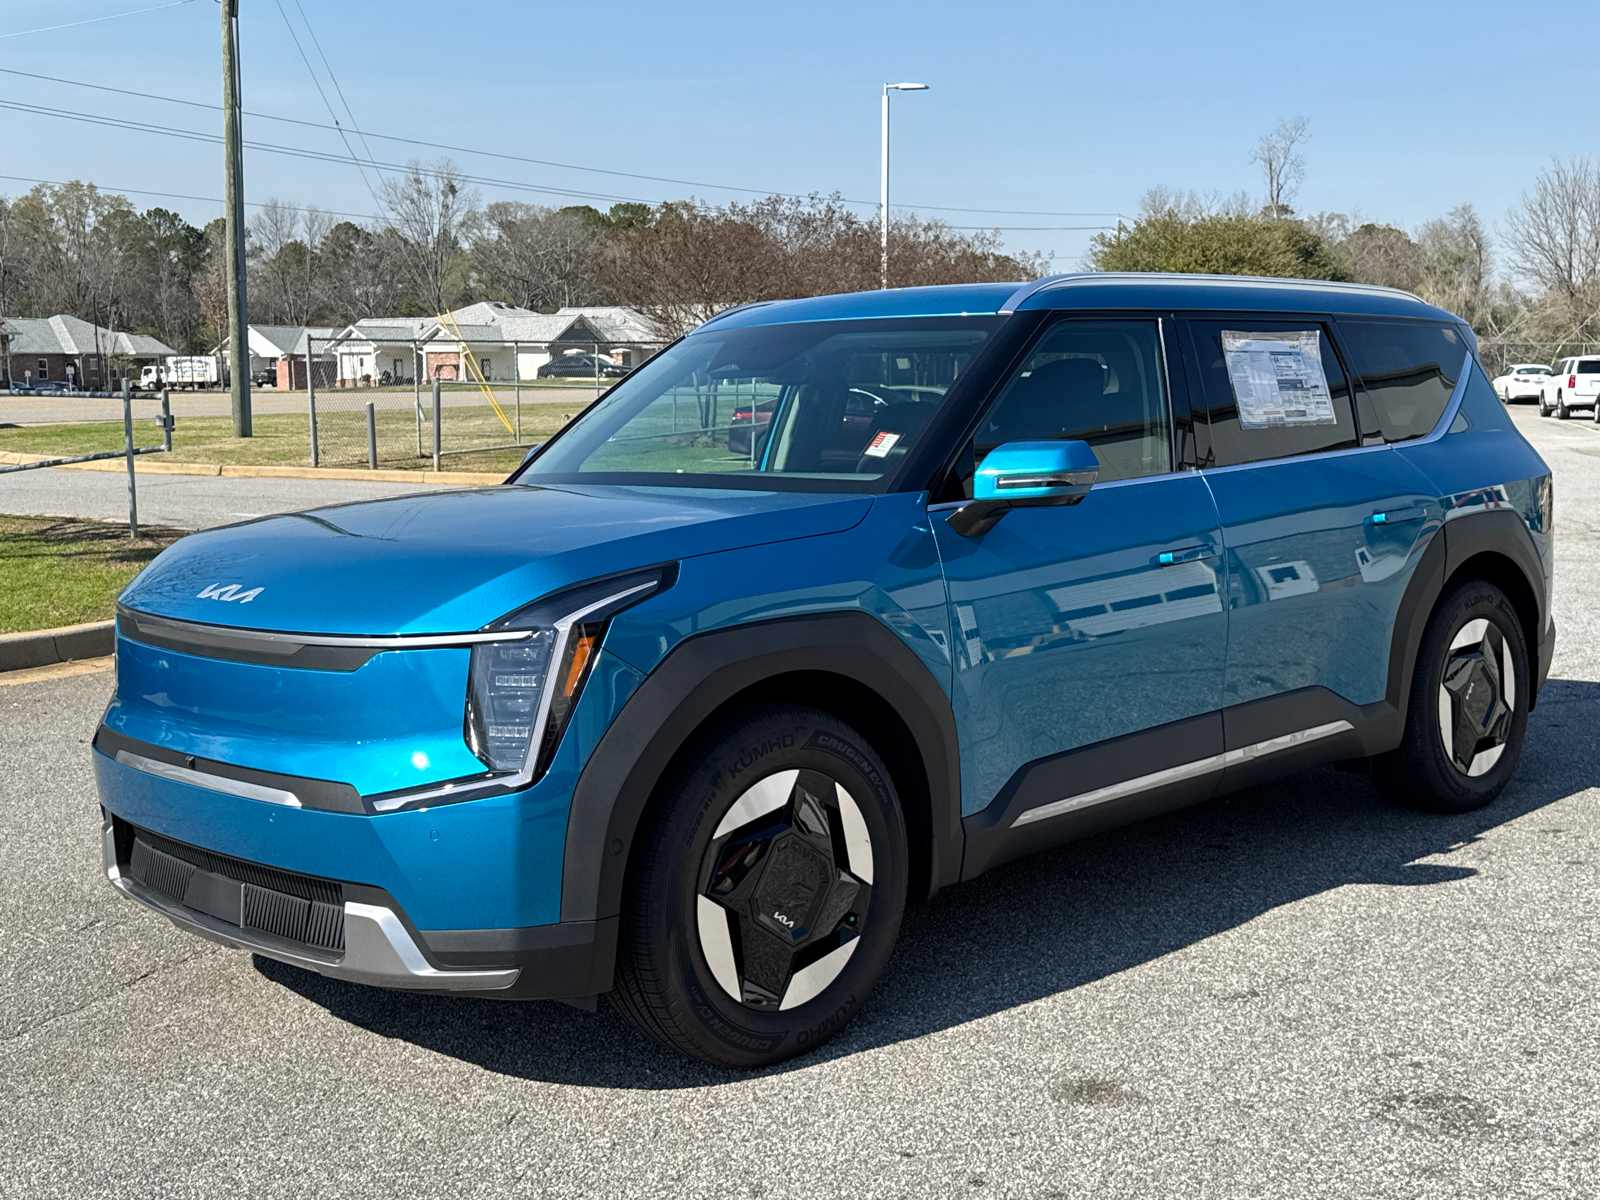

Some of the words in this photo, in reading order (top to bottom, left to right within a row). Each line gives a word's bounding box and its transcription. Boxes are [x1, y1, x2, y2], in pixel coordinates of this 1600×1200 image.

[196, 582, 265, 604] KIA
[1464, 594, 1494, 610] KUMHO
[727, 733, 795, 779] KUMHO
[817, 734, 873, 774] CRUGEN
[869, 770, 883, 786] EV
[773, 911, 795, 929] KIA
[709, 1018, 773, 1051] CRUGEN
[796, 994, 857, 1045] KUMHO
